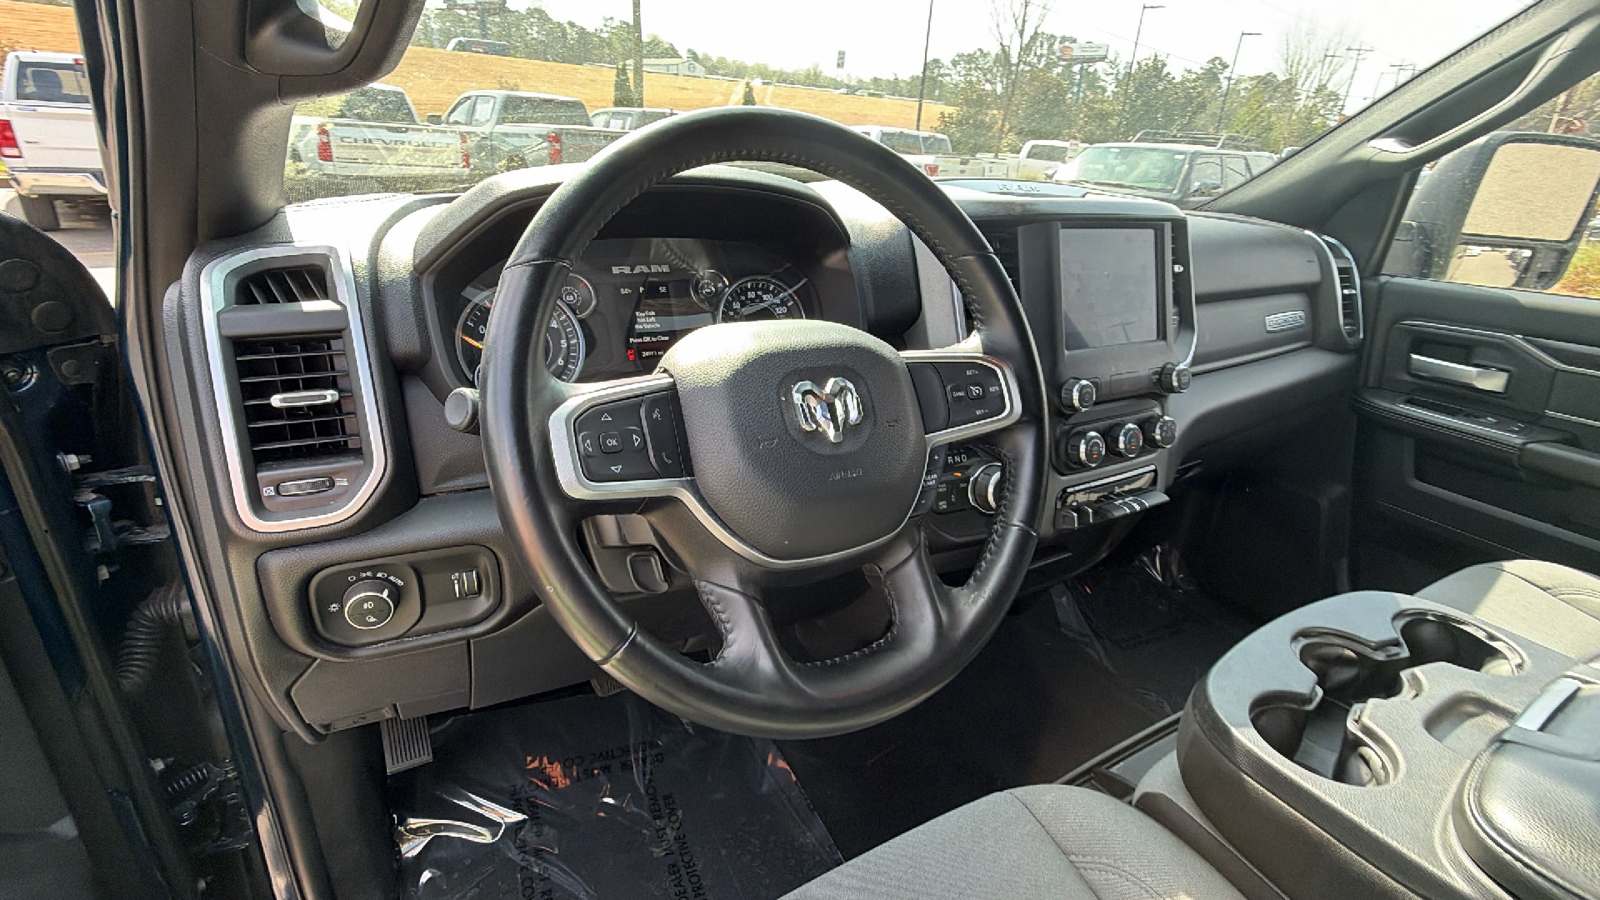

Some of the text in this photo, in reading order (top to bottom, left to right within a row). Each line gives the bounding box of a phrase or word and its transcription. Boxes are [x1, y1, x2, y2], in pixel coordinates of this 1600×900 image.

[339, 136, 454, 148] CHEVROLET
[611, 264, 671, 274] RAM
[747, 291, 756, 299] 80
[762, 293, 774, 301] 100
[775, 306, 788, 314] 120
[549, 320, 559, 329] 4
[560, 340, 567, 348] 5
[557, 357, 564, 366] 6
[606, 438, 618, 447] OK
[947, 454, 968, 464] R N D
[388, 575, 404, 587] AUTO
[662, 792, 706, 899] PROTECTIVE COVER
